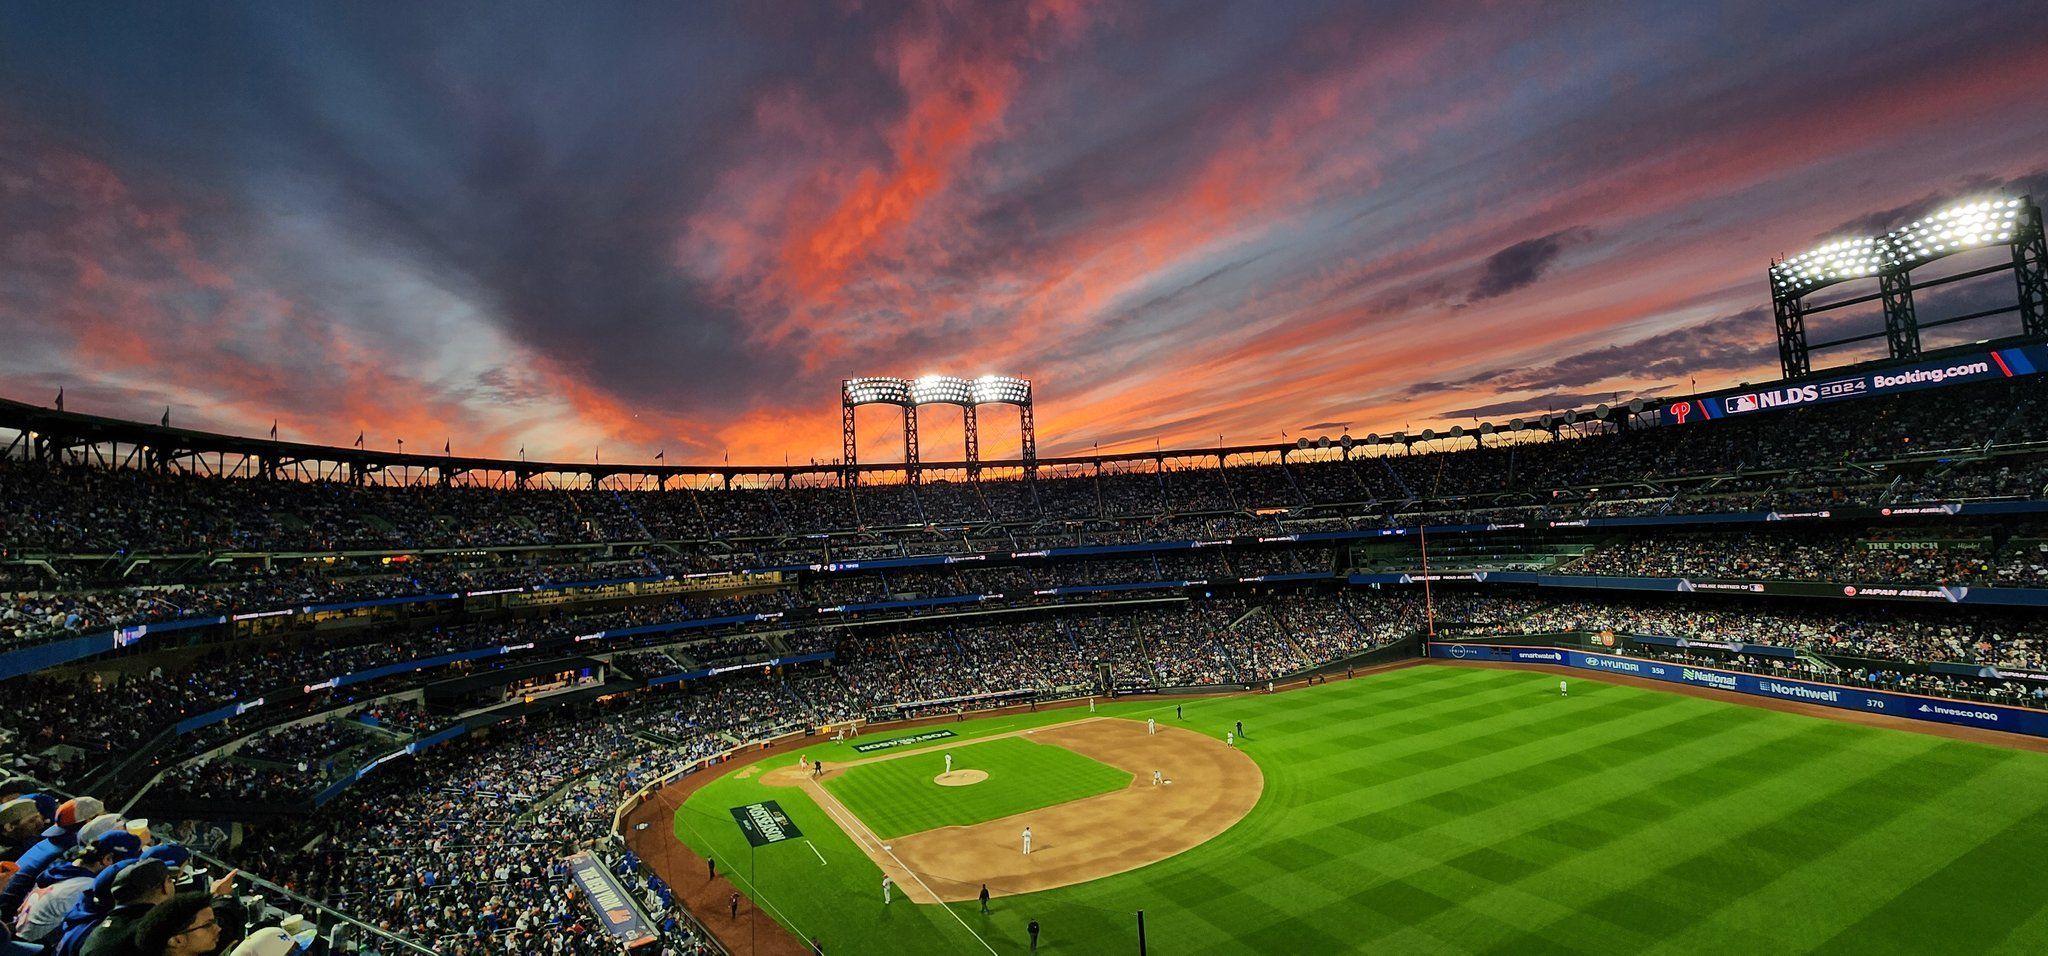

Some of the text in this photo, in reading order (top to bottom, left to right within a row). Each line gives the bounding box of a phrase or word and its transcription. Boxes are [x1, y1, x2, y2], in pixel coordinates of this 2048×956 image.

[1873, 361, 1988, 389] Booking.com
[1820, 381, 1867, 395] 2024
[1760, 384, 1819, 409] NLDS
[1866, 542, 1938, 550] THE PORCH
[1859, 588, 1898, 596] JAPAN
[1519, 652, 1555, 660] smartwater
[1600, 659, 1639, 672] HYUNDAI
[1651, 667, 1665, 675] 358
[1694, 671, 1737, 686] National
[1770, 683, 1837, 702] Northwell
[1866, 699, 1884, 709] 370
[1934, 705, 1998, 721] Invesco QQQ
[746, 803, 786, 842] POSTSEASON
